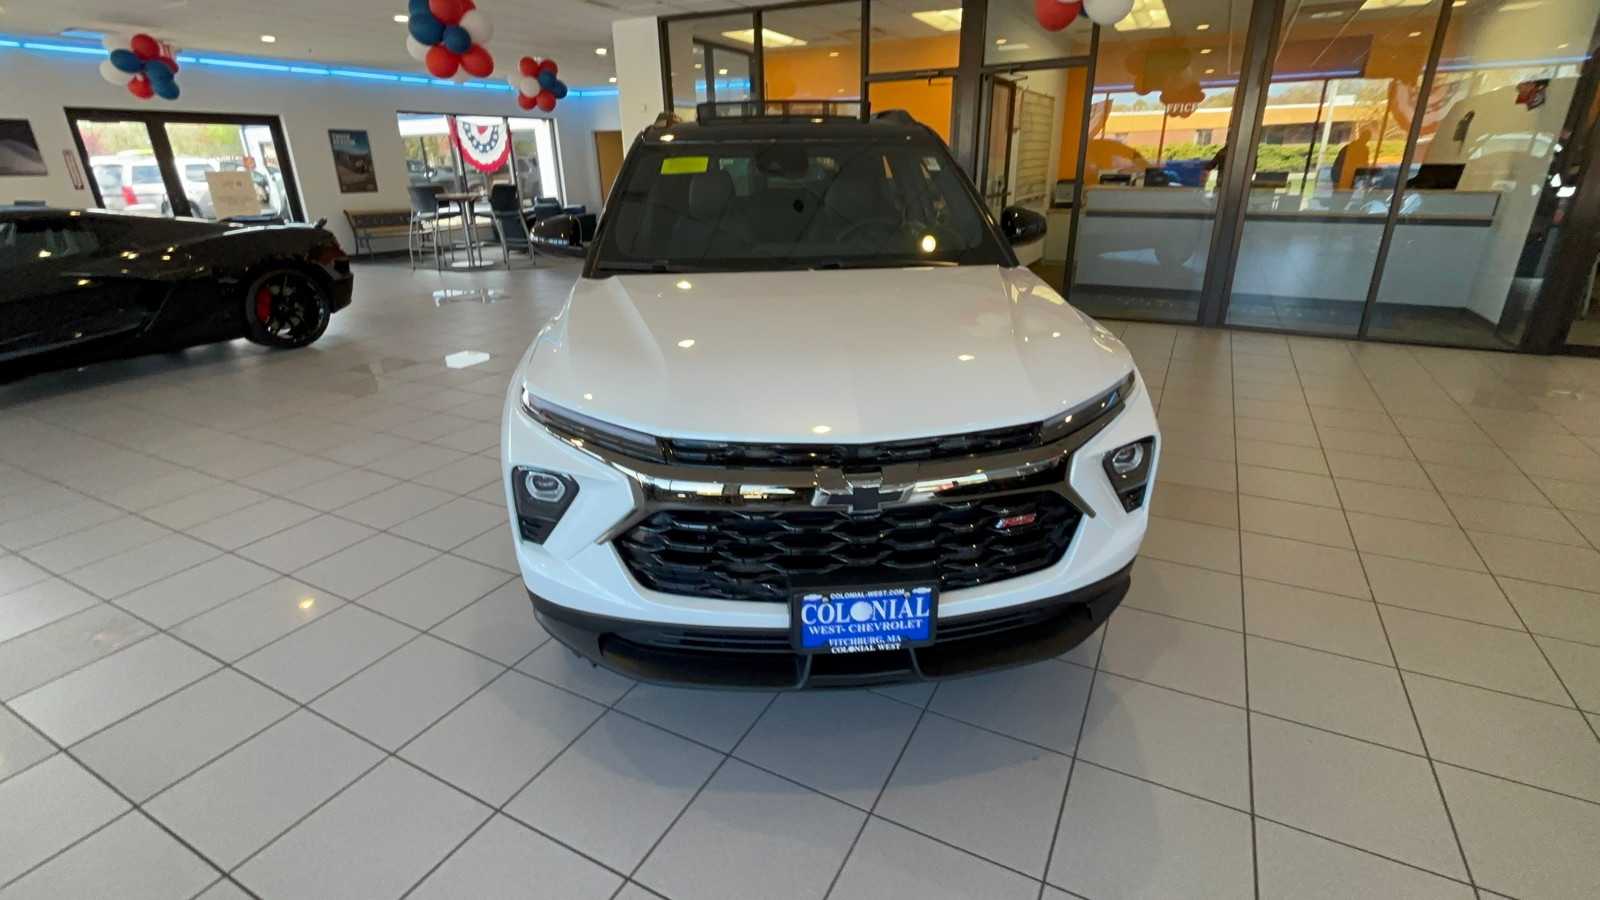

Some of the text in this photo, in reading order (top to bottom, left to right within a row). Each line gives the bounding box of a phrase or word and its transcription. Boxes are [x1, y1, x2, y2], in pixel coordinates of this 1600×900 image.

[801, 597, 930, 625] COLONIAL
[848, 619, 924, 634] CHEVROLET
[887, 634, 902, 643] MA
[831, 642, 901, 654] COLONIAL WEST
